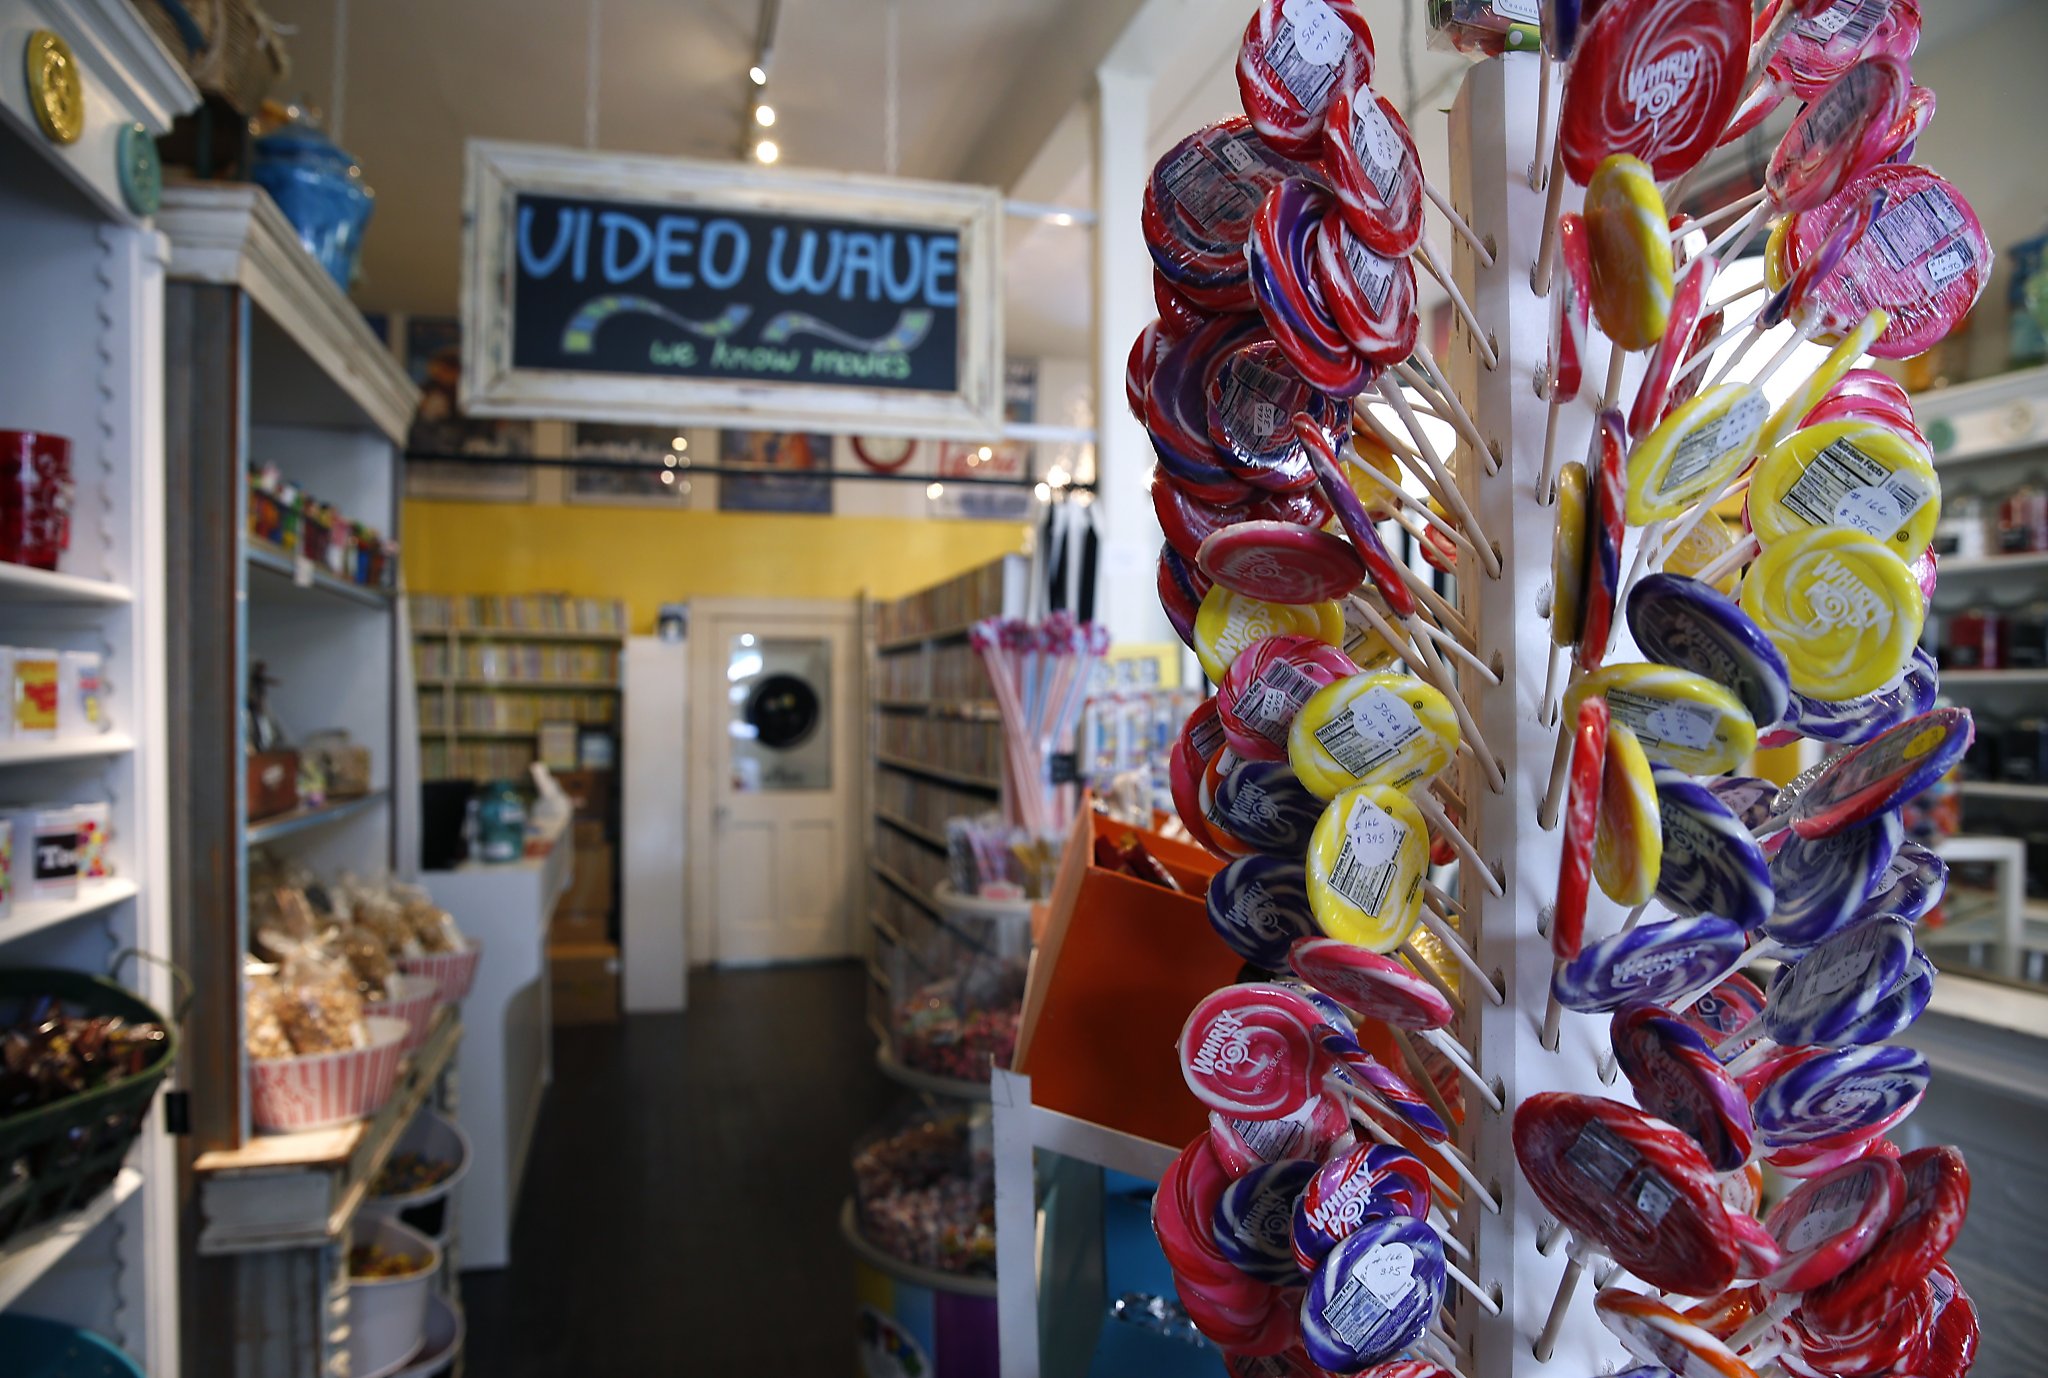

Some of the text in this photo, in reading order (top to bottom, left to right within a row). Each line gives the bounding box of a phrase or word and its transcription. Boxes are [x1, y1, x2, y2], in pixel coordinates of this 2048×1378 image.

[1628, 45, 1703, 103] WHIRLY
[1635, 79, 1688, 121] POP
[517, 205, 959, 307] VIDEO WAVE
[650, 341, 698, 367] we
[712, 336, 800, 375] know
[1837, 439, 1884, 478] Nutrition Facts
[1805, 580, 1860, 628] POP
[1812, 553, 1893, 628] WHIRLY
[1215, 599, 1258, 658] WHIRL
[1315, 709, 1355, 737] Nutrition Facts
[1228, 778, 1267, 824] WHIRLY
[1250, 795, 1280, 827] POP
[1329, 840, 1352, 885] Nutrition Facts
[1225, 881, 1275, 928] WHIRLY
[1247, 902, 1281, 934] POP
[1190, 1009, 1243, 1076] WHIRLY
[1214, 1029, 1251, 1076] POP
[1234, 1188, 1281, 1240] WHIRLY
[1306, 1160, 1374, 1231] WHIRLY
[1328, 1186, 1373, 1235] POP
[1323, 1279, 1355, 1316] Nutrition Facts
